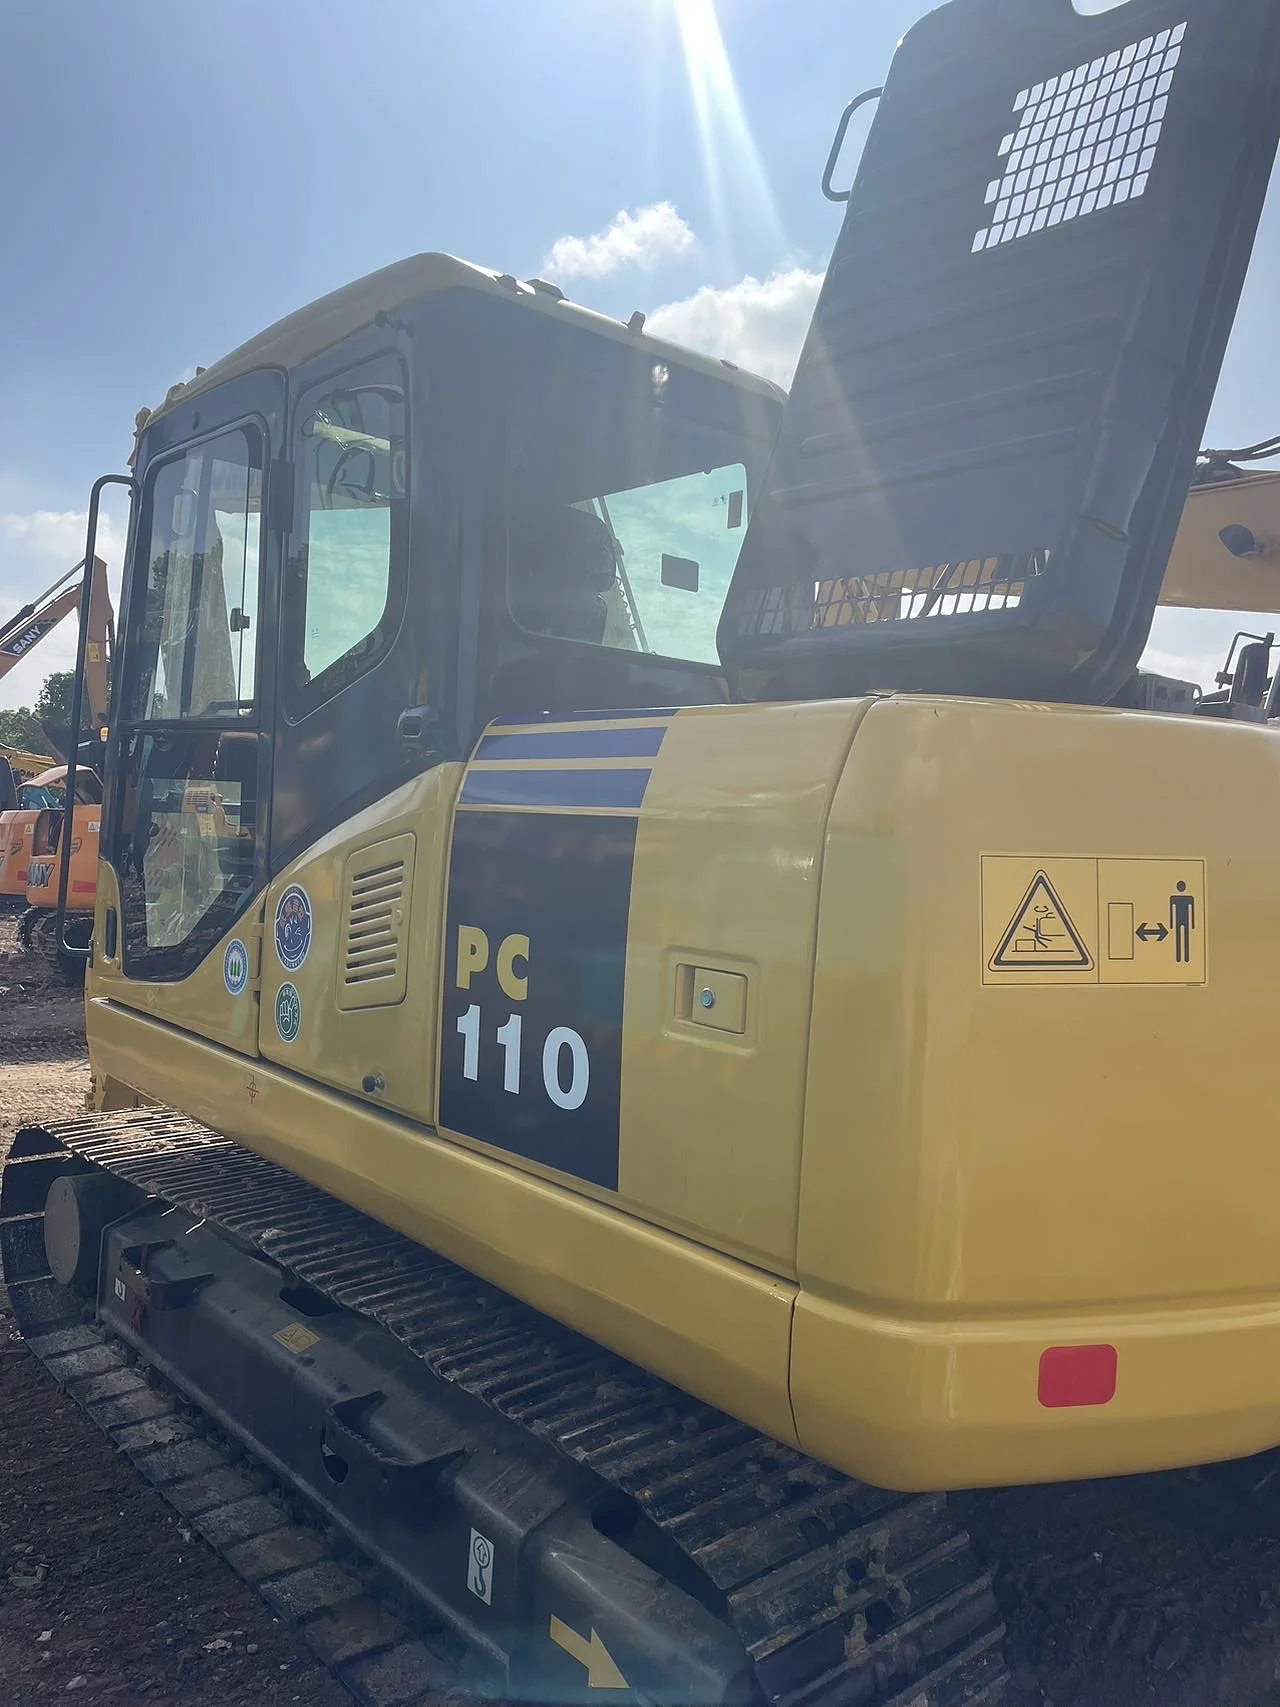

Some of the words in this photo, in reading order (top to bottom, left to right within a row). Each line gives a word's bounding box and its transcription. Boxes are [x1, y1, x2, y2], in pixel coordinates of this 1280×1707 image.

[12, 625, 41, 654] SANY
[456, 924, 530, 1001] PC
[457, 1004, 590, 1110] 110
